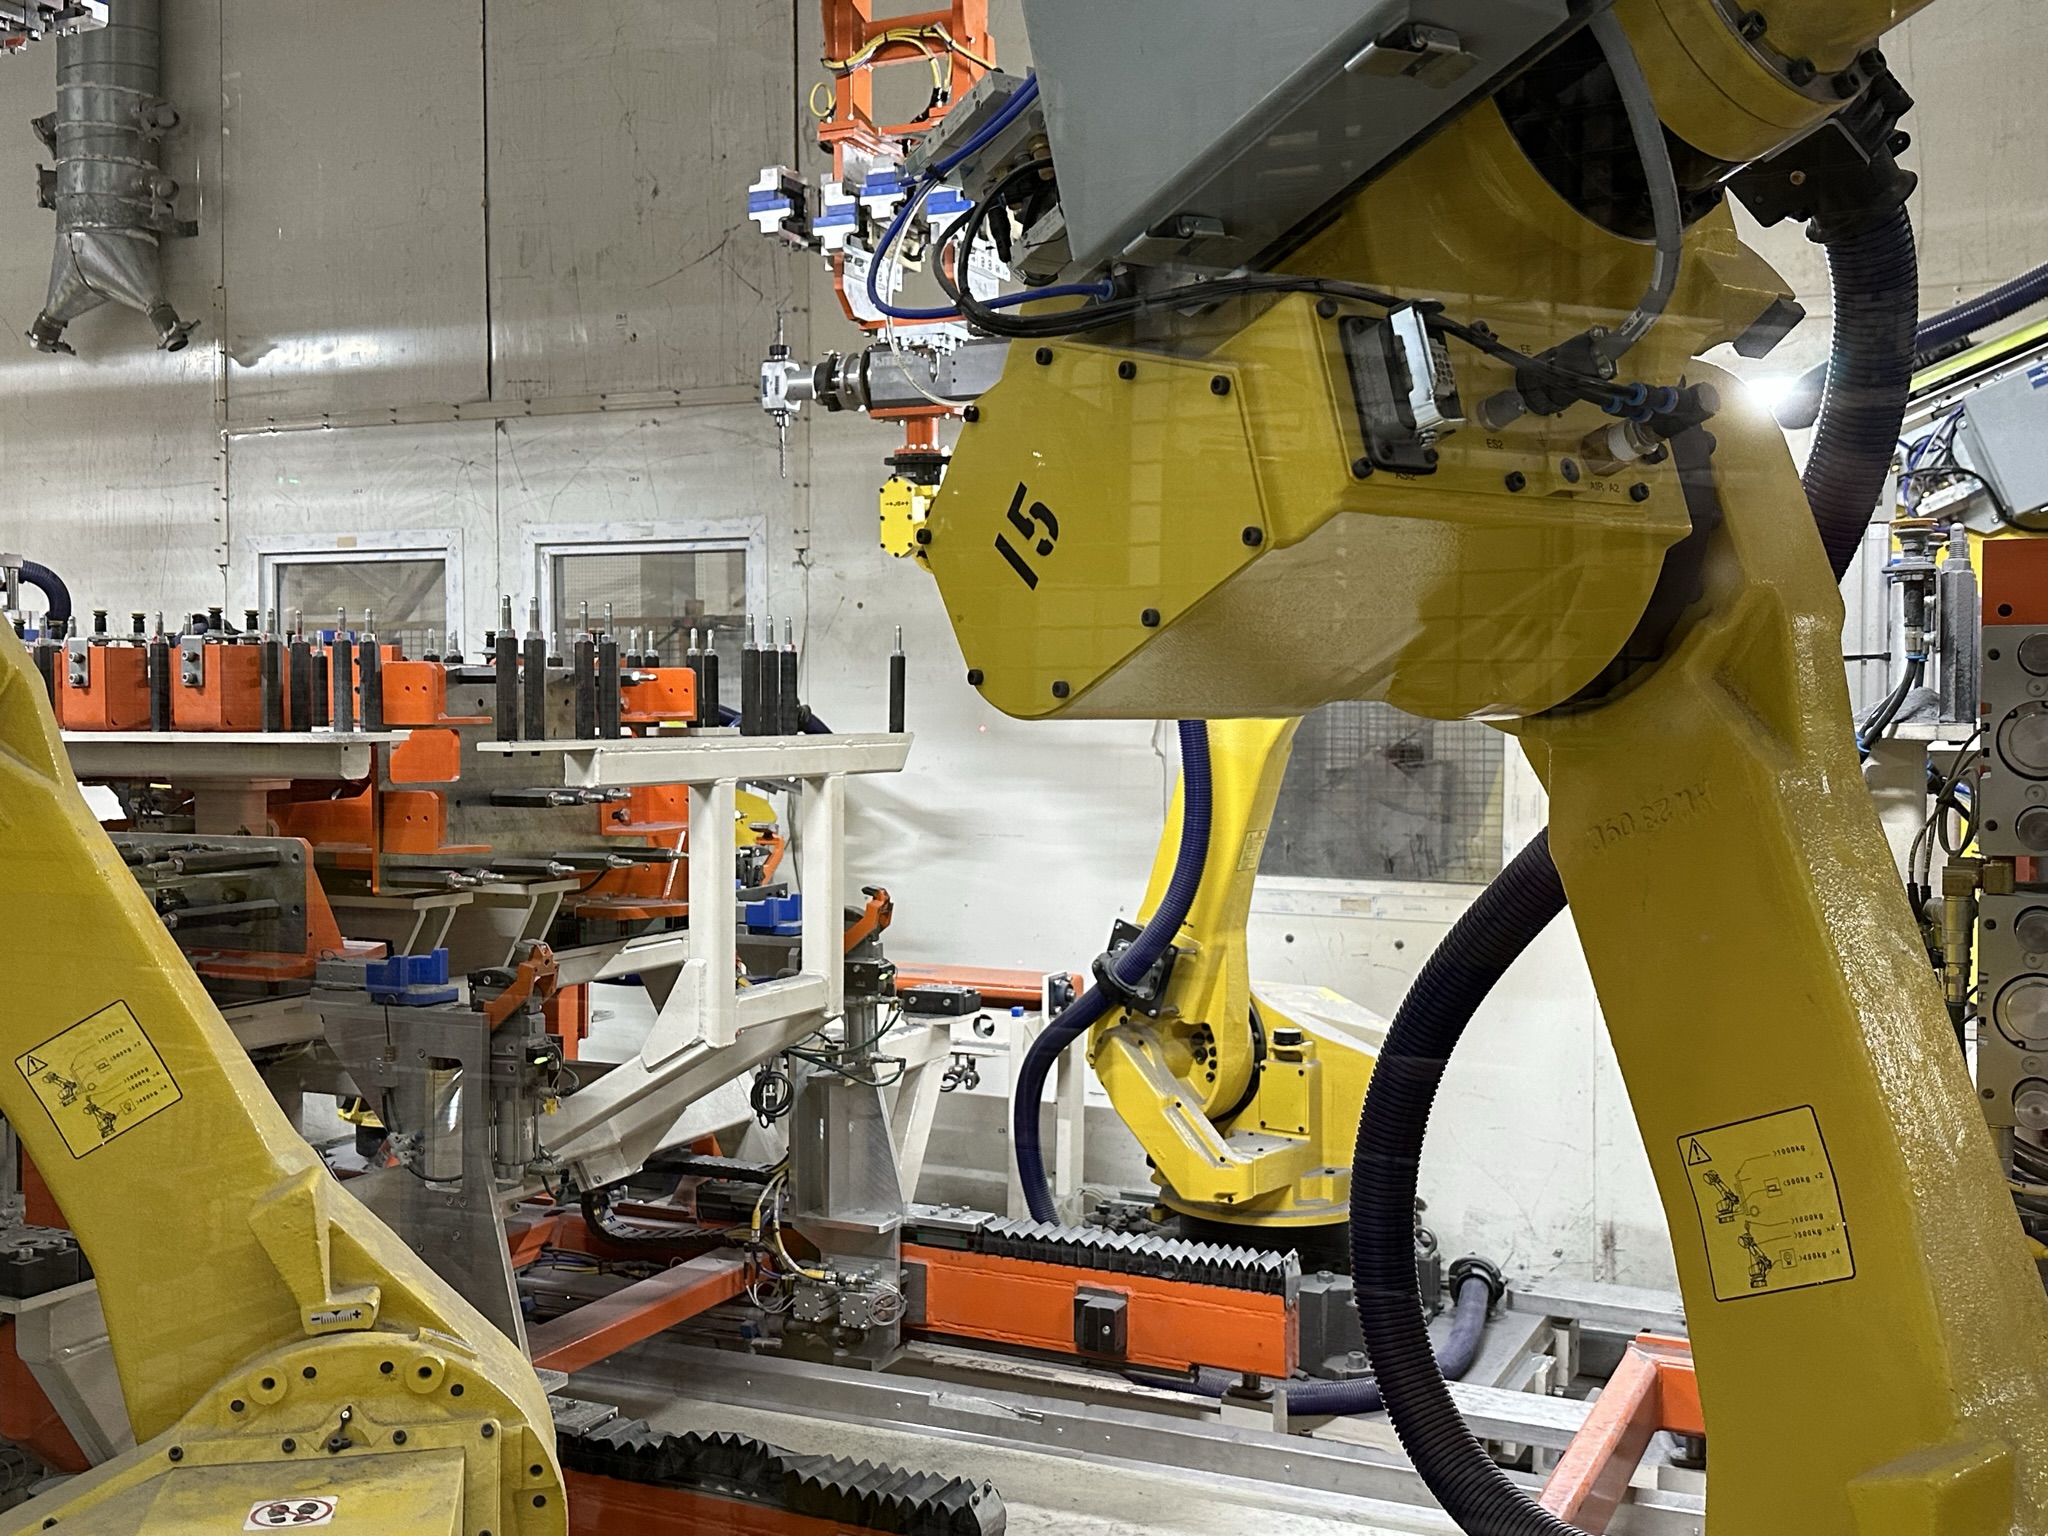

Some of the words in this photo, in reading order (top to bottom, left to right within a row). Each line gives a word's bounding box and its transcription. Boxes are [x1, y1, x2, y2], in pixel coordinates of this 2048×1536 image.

[1520, 344, 1532, 355] EE
[1486, 438, 1504, 450] ES2
[1609, 483, 1621, 493] A2
[994, 481, 1059, 591] 15
